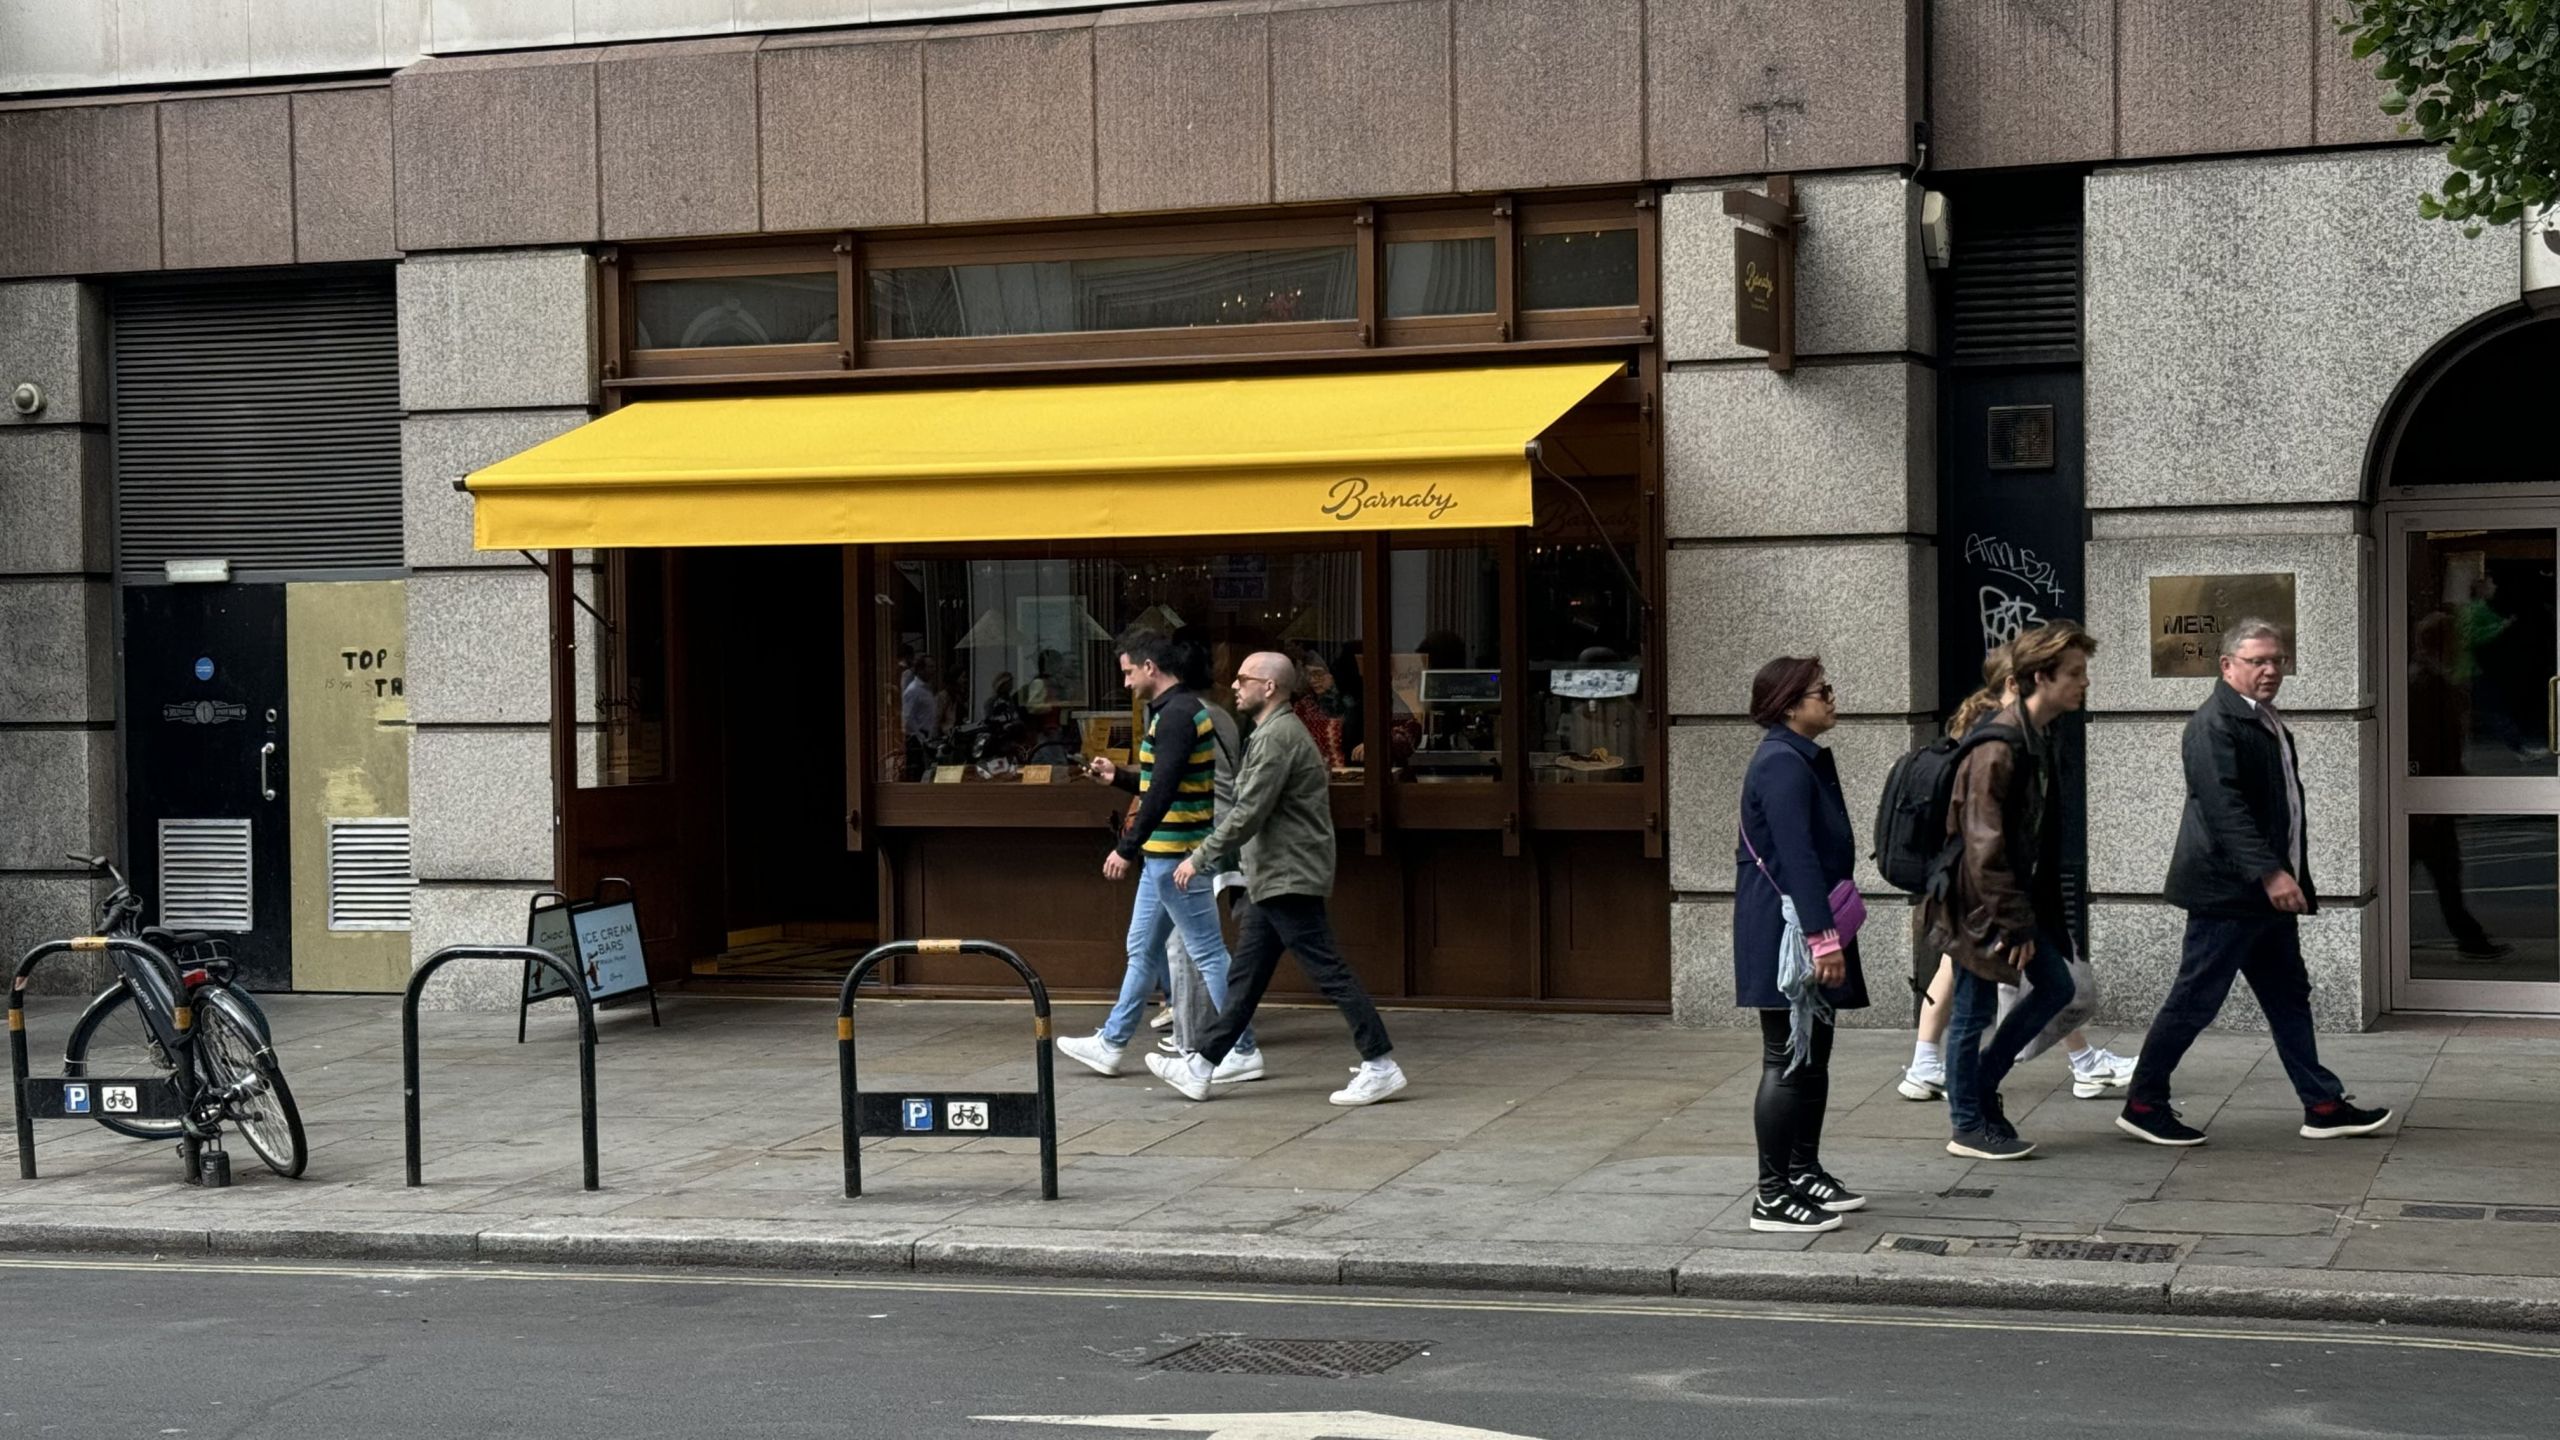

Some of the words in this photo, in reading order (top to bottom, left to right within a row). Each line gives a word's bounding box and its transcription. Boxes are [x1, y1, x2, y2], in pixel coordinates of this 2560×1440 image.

[1321, 477, 1458, 521] Barnaby
[2163, 615, 2223, 635] MERI
[341, 648, 388, 671] TOP
[582, 930, 598, 945] ICE
[600, 923, 633, 941] CREAM
[598, 939, 624, 955] BARS
[69, 1086, 86, 1110] P
[908, 1101, 928, 1128] P
